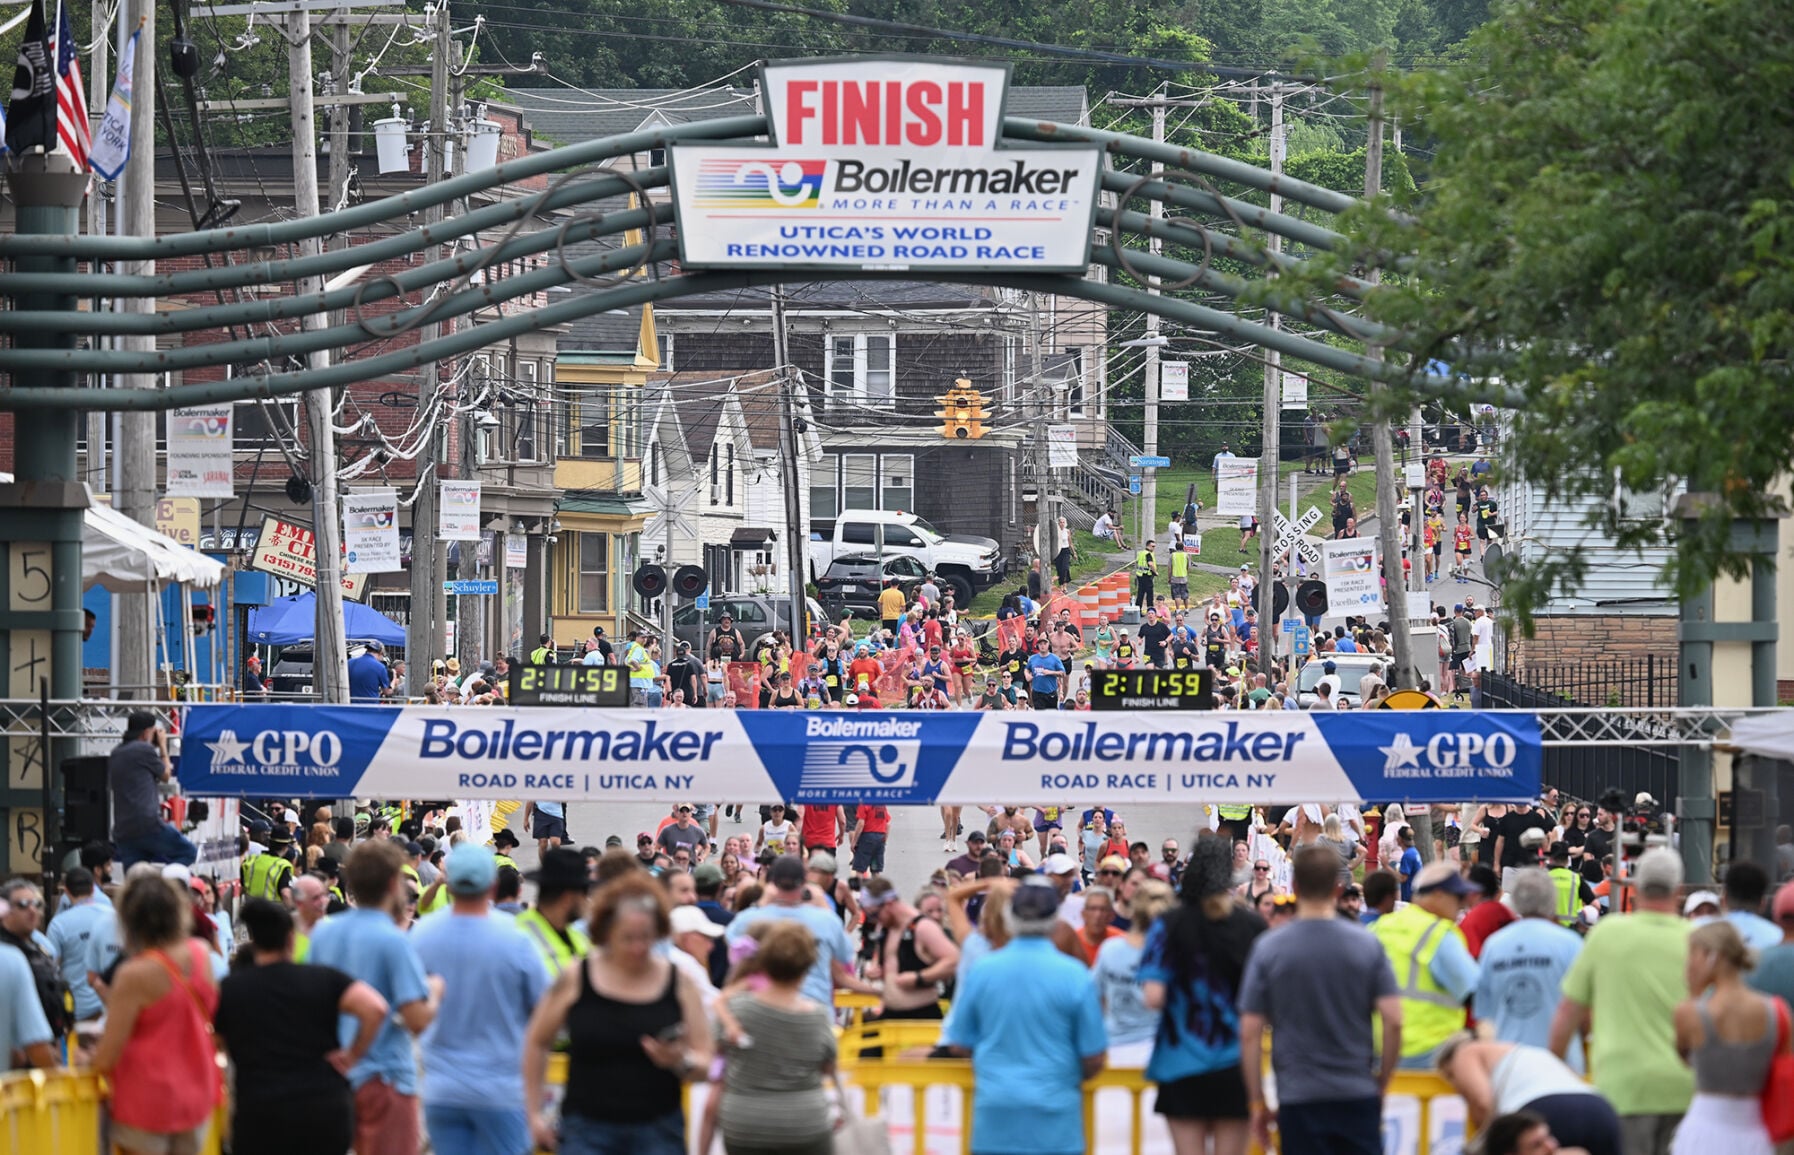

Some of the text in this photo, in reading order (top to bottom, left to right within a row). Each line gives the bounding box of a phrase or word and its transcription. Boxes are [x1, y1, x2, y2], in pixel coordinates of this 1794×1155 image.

[785, 80, 985, 146] FINISH
[101, 128, 126, 152] YORK
[833, 159, 1080, 195] Boilermaker
[832, 199, 897, 210] MORE
[911, 199, 973, 211] THAN
[984, 200, 997, 211] A
[779, 226, 992, 241] UTICA'S WORLD
[727, 243, 1045, 259] RENOWNED ROAD RACE
[348, 505, 394, 513] Boilermaker
[1273, 510, 1318, 560] ROSSING
[1273, 515, 1319, 564] AIL ROAD
[279, 552, 304, 564] CHINESE
[288, 540, 316, 561] CI
[1329, 549, 1374, 559] Boilermaker
[263, 554, 295, 570] (315)
[453, 581, 491, 593] Schuyler
[539, 692, 598, 704] FINISH LINE
[1122, 697, 1180, 708] FINISH LINE
[805, 716, 922, 738] Boilermaker
[252, 729, 343, 767] GPO
[418, 718, 724, 763] Boilermaker
[1000, 720, 1306, 763] Boilermaker
[1426, 732, 1517, 769] GPO
[210, 764, 340, 777] FEDERAL CREDIT UNION
[1384, 767, 1514, 779] FEDERAL CREDIT UNION
[459, 774, 517, 789] ROAD
[525, 774, 574, 789] RACE
[600, 775, 658, 790] UTICA
[665, 775, 694, 790] NY
[1041, 773, 1100, 789] ROAD
[1107, 774, 1157, 789] RACE
[1181, 774, 1240, 789] UTICA
[1247, 774, 1277, 789] NY
[797, 789, 827, 798] MORE
[832, 789, 861, 798] THAN
[864, 789, 872, 798] A
